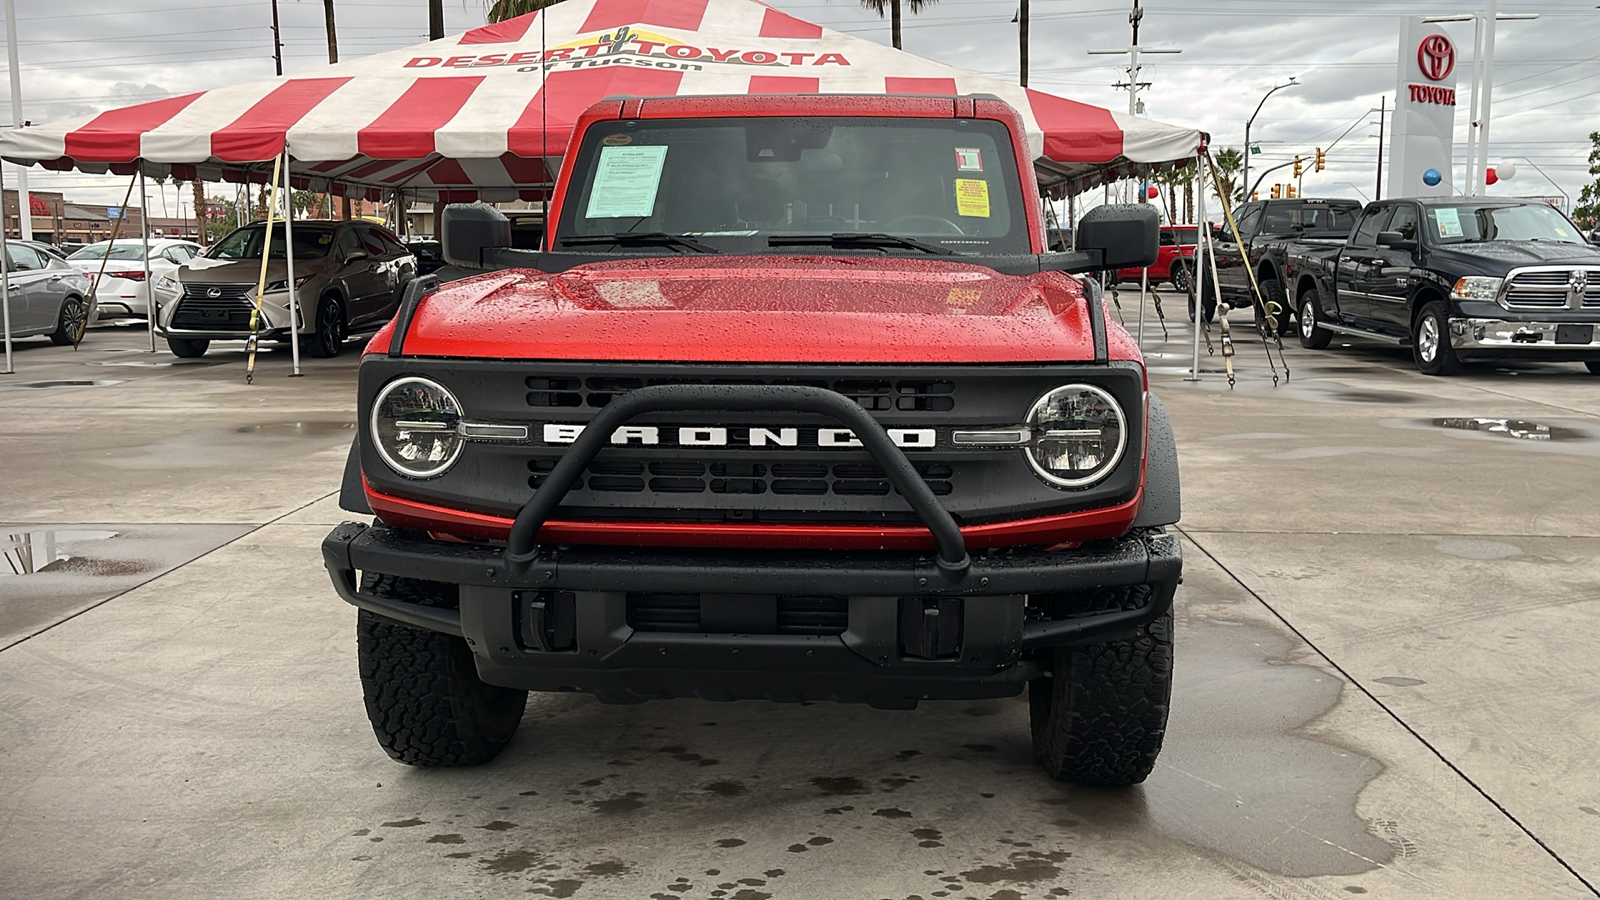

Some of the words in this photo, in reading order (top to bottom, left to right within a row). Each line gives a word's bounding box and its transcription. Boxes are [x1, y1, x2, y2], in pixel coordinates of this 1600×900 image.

[402, 42, 611, 68] DESERT
[631, 39, 851, 66] TOYOTA
[516, 62, 558, 73] of
[566, 57, 703, 71] Tucson
[1408, 84, 1456, 106] TOYOTA
[543, 424, 937, 448] BRONCO
